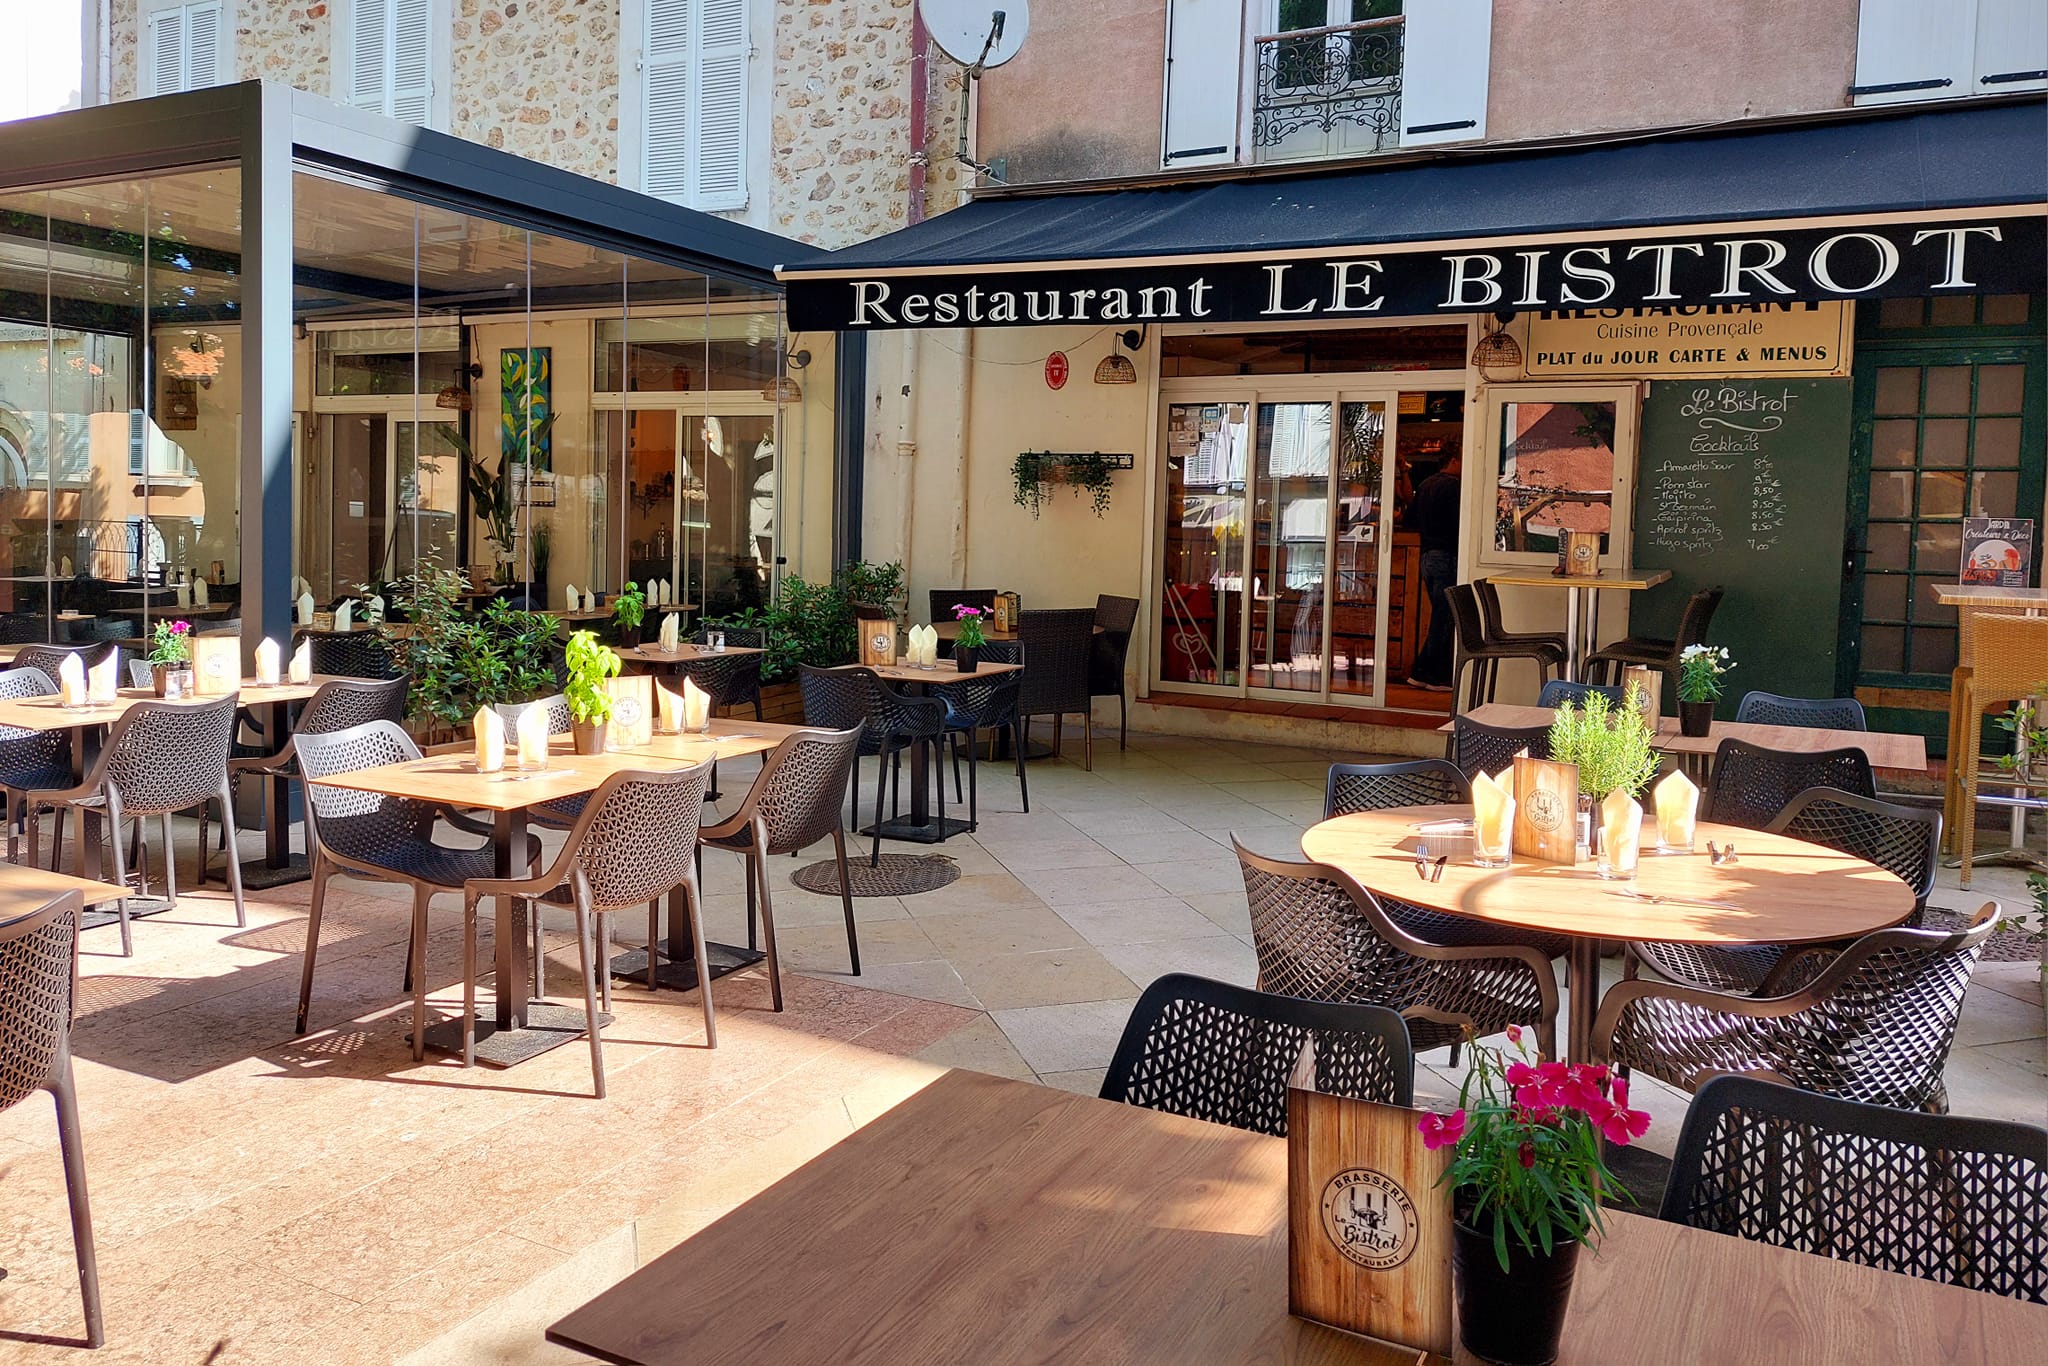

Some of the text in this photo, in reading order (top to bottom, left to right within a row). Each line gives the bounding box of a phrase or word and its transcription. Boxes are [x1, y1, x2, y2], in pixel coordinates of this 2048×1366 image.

[848, 226, 2003, 326] Restaurant LE BISTROT
[1597, 319, 1764, 340] Cuisine Provençale
[1537, 345, 1828, 365] PLAT du JOUR CARTE & MENUS
[1681, 387, 1799, 417] Le Bistrot
[1689, 432, 1760, 452] Cocktails
[1334, 1173, 1412, 1212] BRASSERIE
[1343, 1224, 1402, 1250] Bistrot
[1340, 1244, 1401, 1267] RESTAURANT
